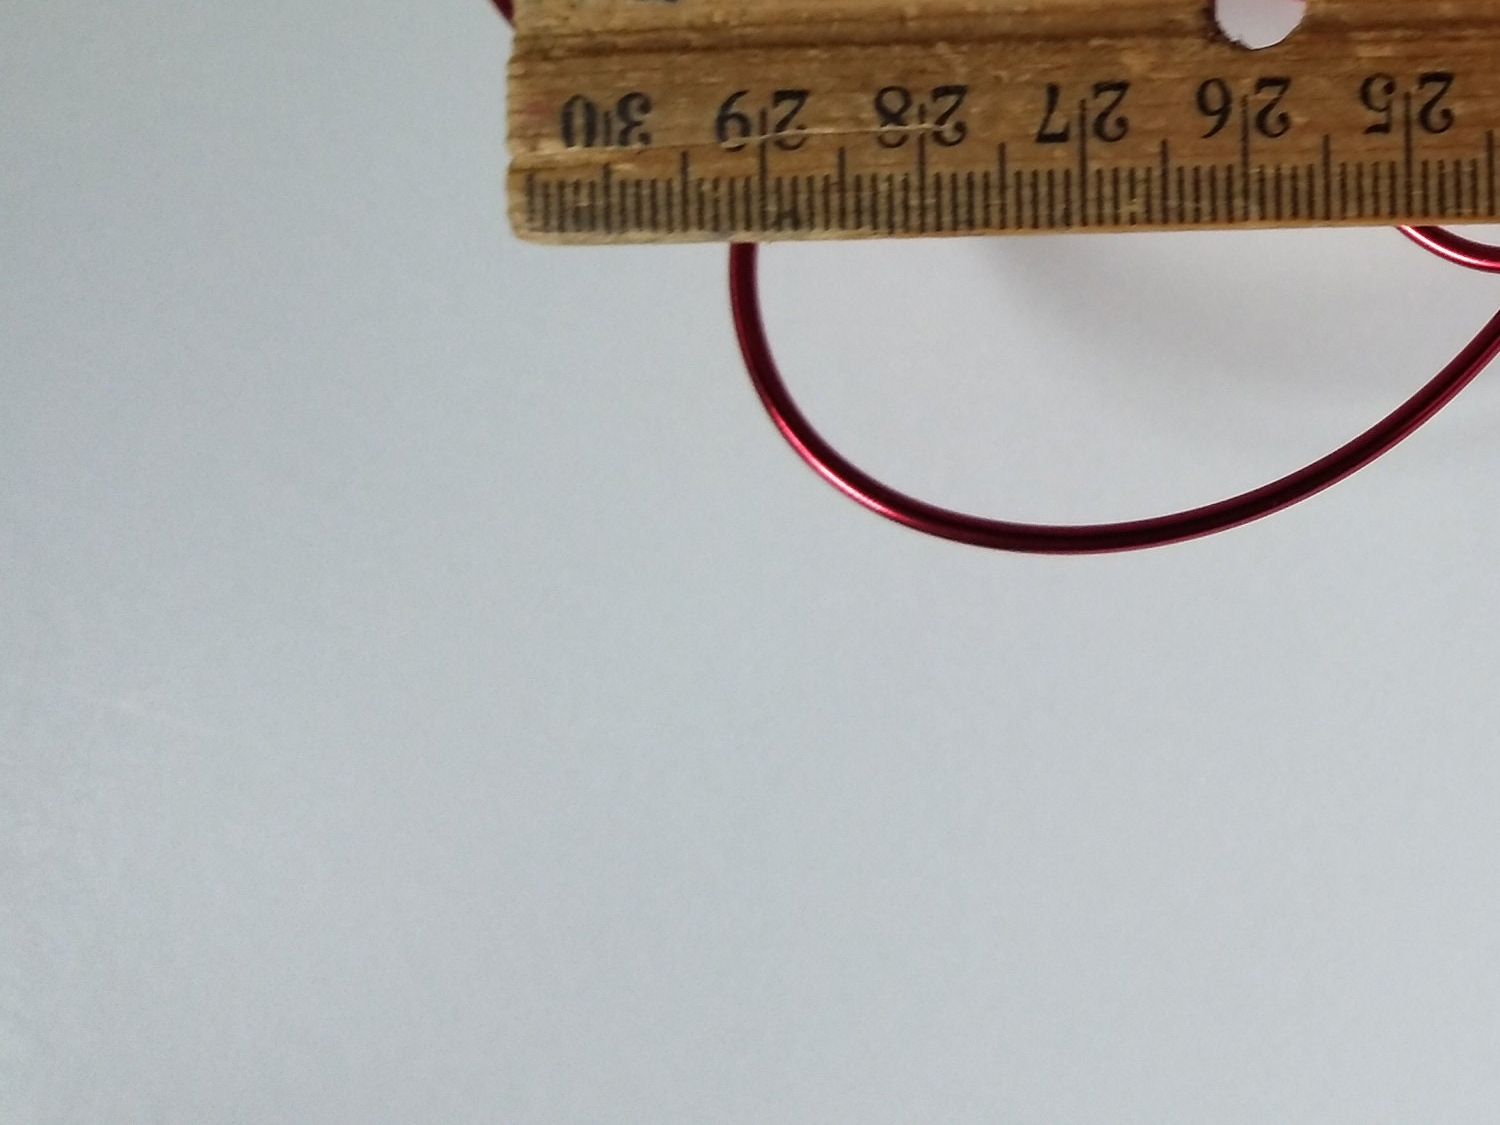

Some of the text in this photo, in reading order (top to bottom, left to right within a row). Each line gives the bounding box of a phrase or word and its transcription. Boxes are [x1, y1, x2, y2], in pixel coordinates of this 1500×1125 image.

[560, 92, 653, 149] 30
[715, 89, 810, 152] 29
[873, 84, 970, 149] 28
[1035, 81, 1130, 143] 27
[1196, 77, 1292, 139] 26
[1358, 72, 1455, 135] 25
